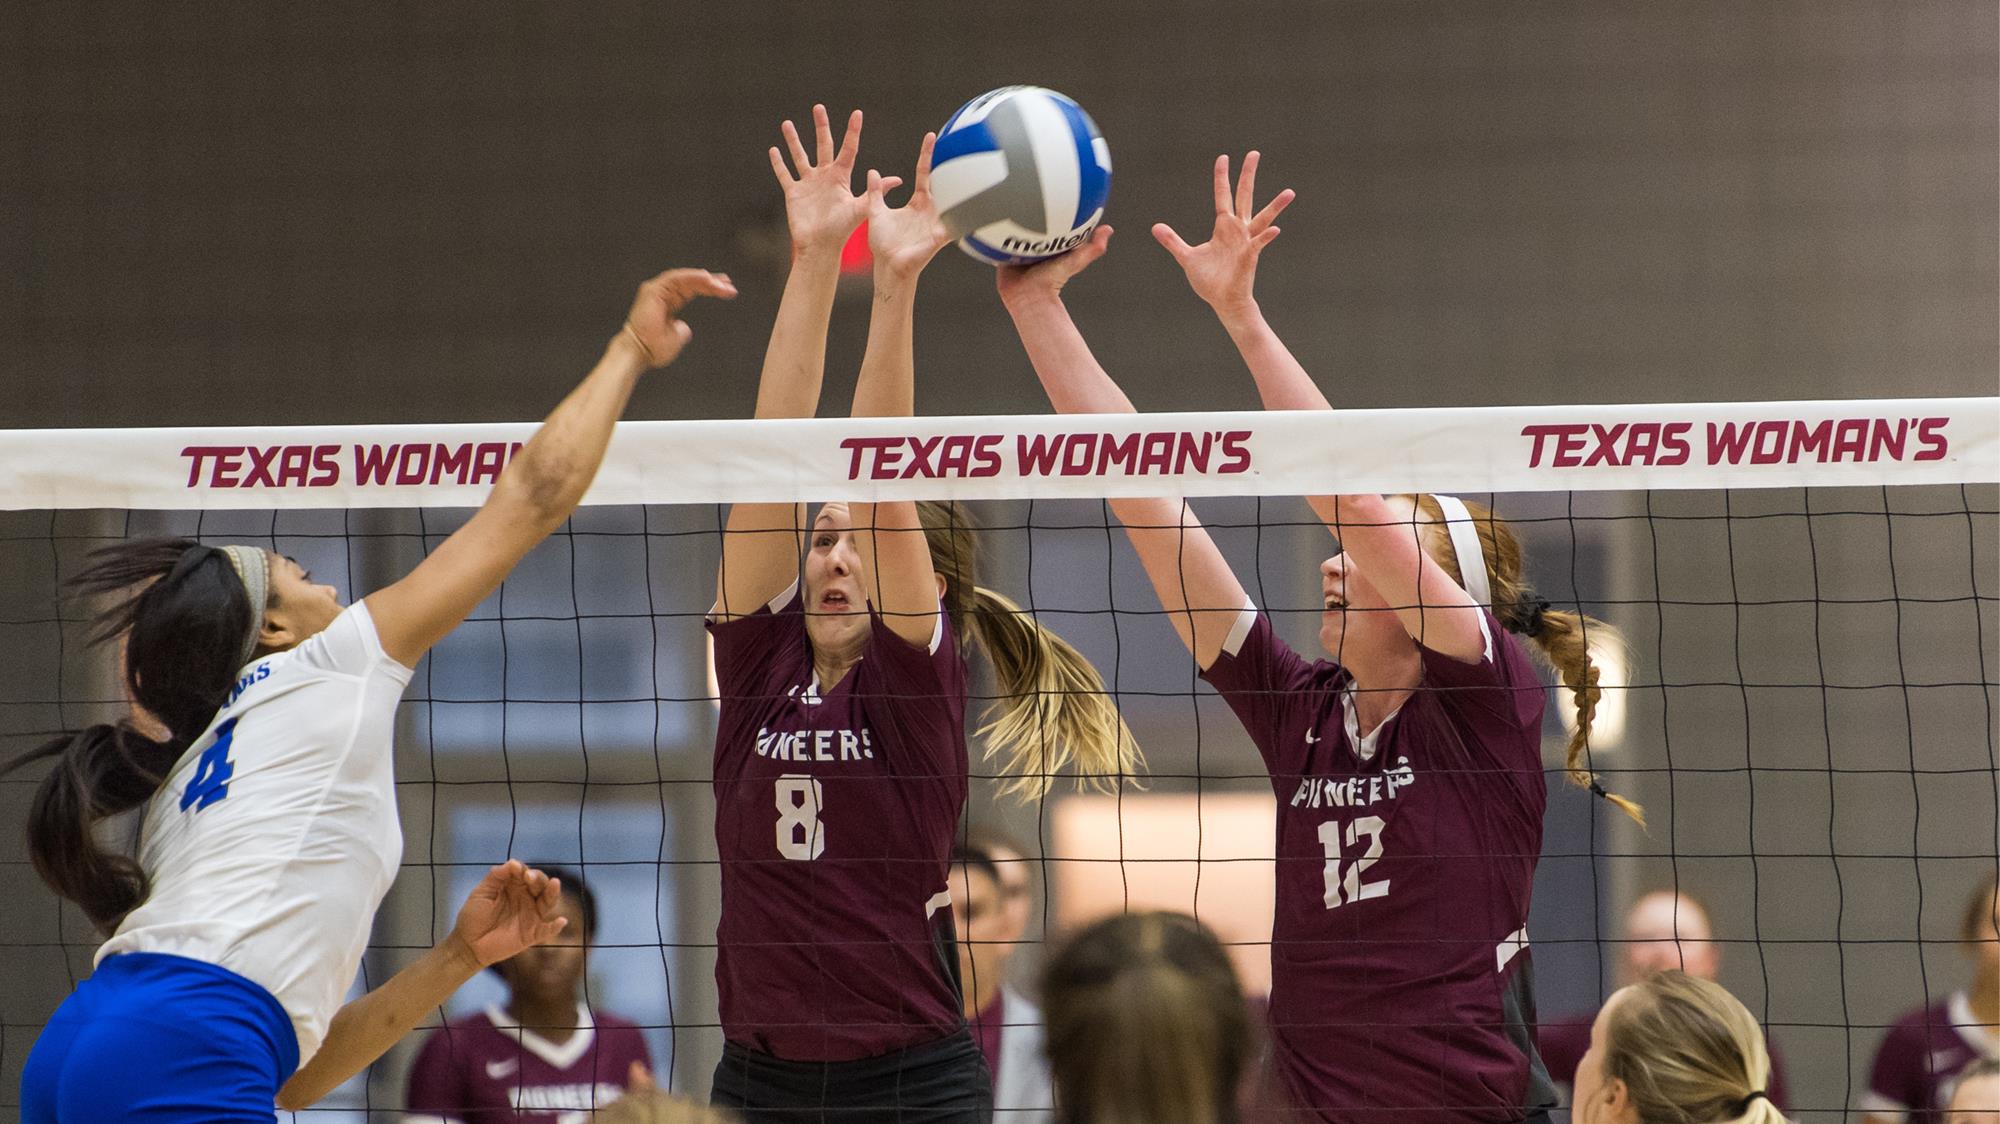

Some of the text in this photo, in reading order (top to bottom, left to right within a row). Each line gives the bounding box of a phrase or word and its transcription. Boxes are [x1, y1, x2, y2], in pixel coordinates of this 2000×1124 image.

[180, 445, 342, 488] TEXAS
[840, 430, 1252, 480] TEXAS WOMAN'S
[1520, 417, 1950, 468] TEXAS WOMAN'S
[179, 717, 238, 814] 4
[775, 774, 825, 861] 8
[1318, 815, 1390, 909] 12
